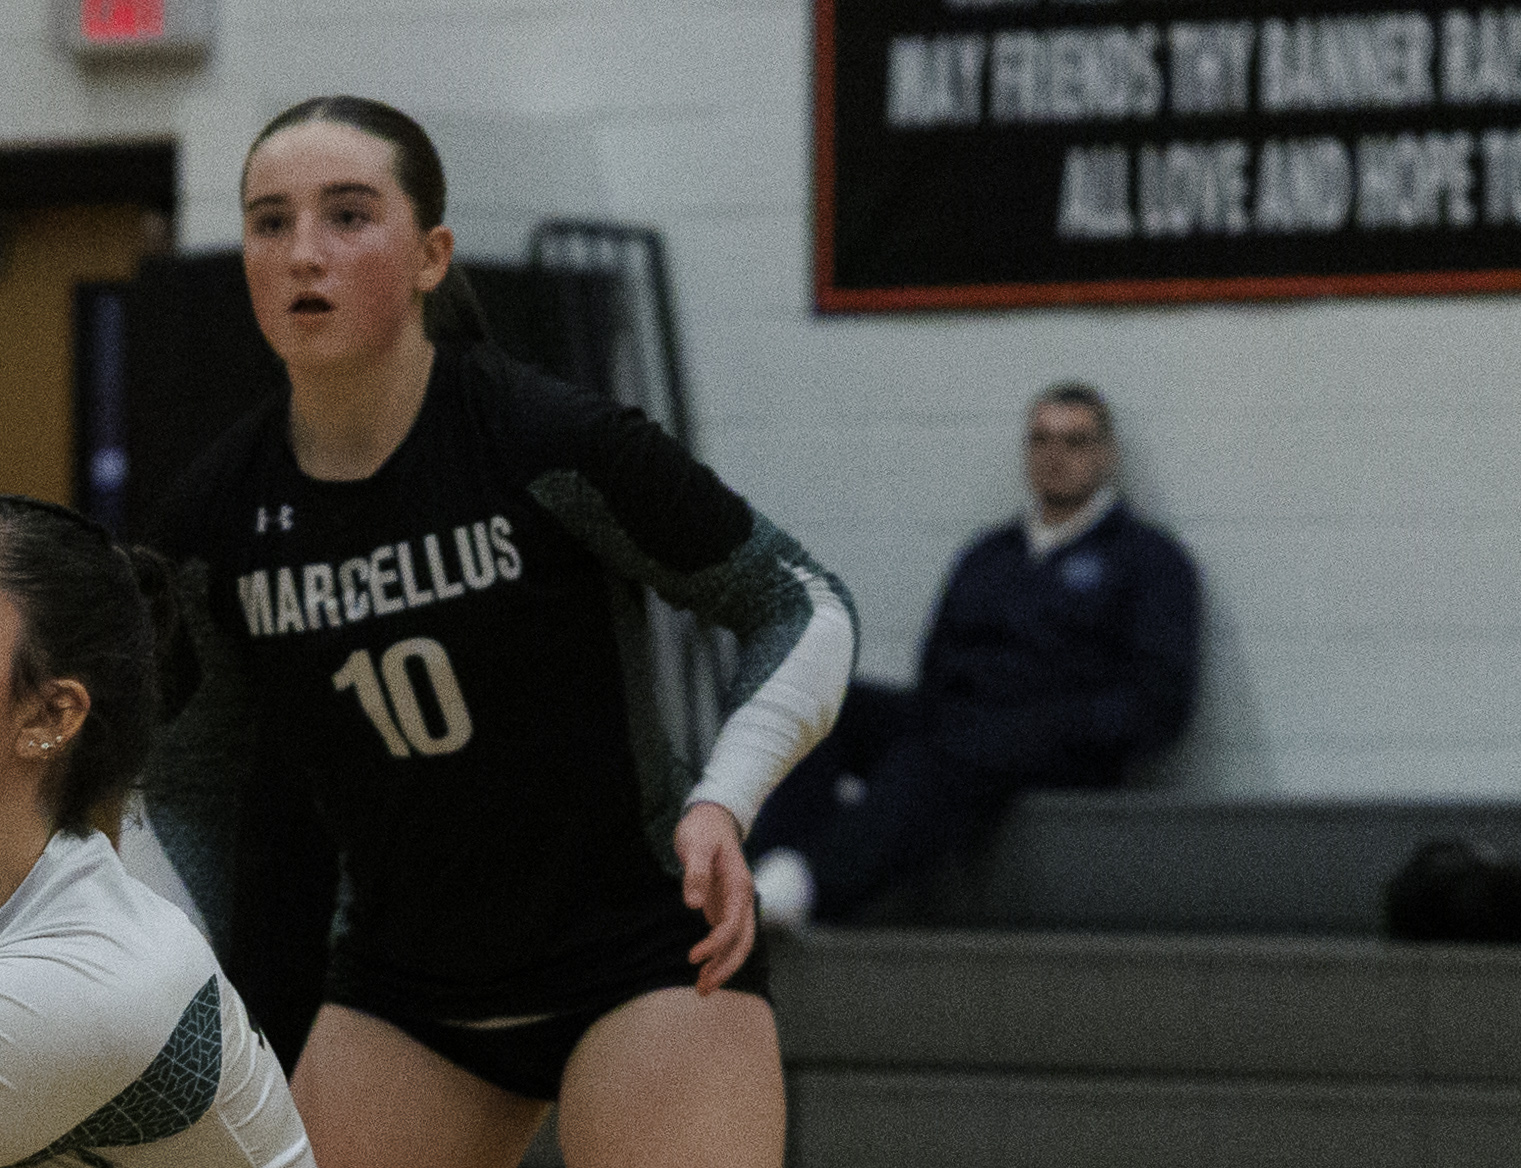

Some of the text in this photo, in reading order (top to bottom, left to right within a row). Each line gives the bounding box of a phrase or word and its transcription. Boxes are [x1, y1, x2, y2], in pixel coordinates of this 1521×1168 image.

[991, 27, 1162, 119] FRIENDS
[1260, 13, 1434, 109] BANNER
[1060, 149, 1134, 237] ALL
[1140, 142, 1249, 235] LOVE
[1255, 138, 1353, 231] AND
[1357, 132, 1475, 228] HOPE
[238, 514, 523, 637] MARCELLUS
[332, 636, 474, 758] 10
